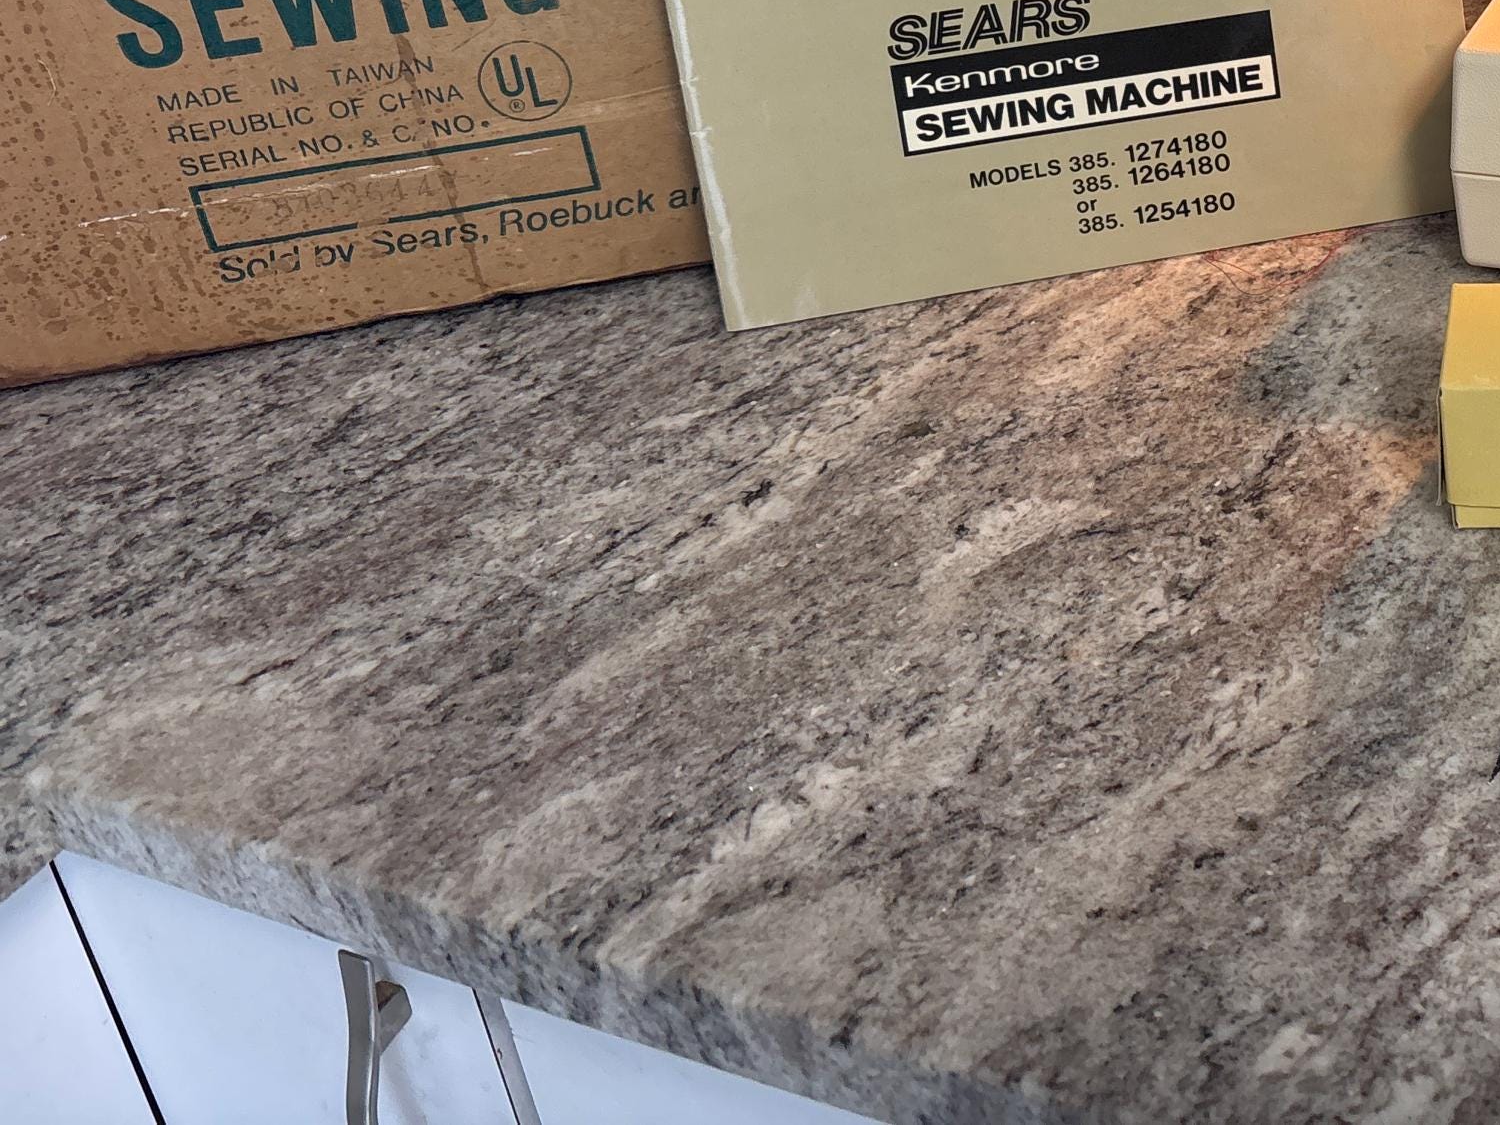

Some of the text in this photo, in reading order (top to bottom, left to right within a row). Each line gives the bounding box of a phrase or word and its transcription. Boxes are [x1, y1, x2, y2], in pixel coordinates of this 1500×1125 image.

[157, 56, 434, 112] MADE IN TAIWAN
[904, 53, 1100, 99] Kenmore
[916, 64, 1263, 141] SEWING MACHINE
[167, 84, 464, 144] REPUBLIC OF CHINA
[179, 145, 287, 176] SERIAL
[298, 135, 353, 157] NO.
[362, 129, 380, 147] &
[431, 115, 490, 137] NO.
[969, 130, 1227, 189] MODELS 385. 1274180
[1072, 153, 1231, 195] 385. 1264180
[371, 222, 489, 255] Sears,
[500, 189, 655, 236] Roebuck
[1077, 197, 1097, 213] or
[1078, 192, 1235, 234] 385. 1254180
